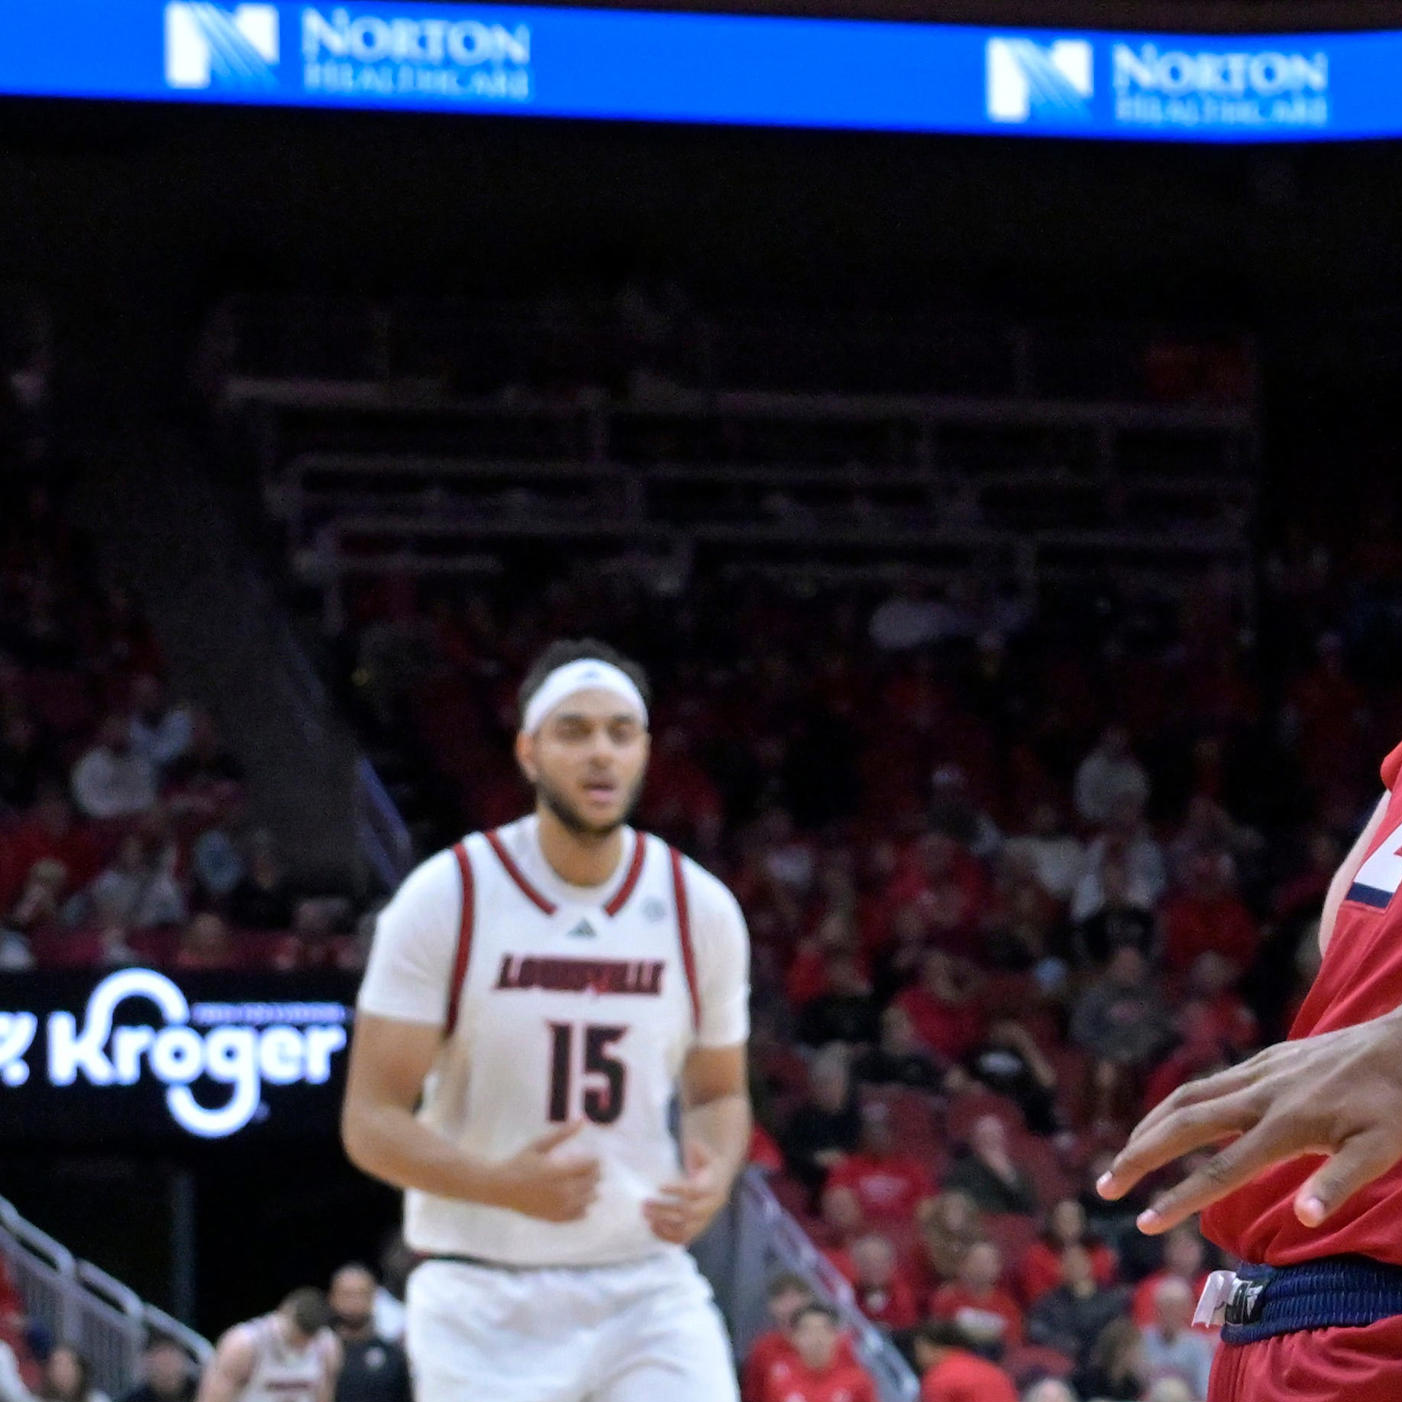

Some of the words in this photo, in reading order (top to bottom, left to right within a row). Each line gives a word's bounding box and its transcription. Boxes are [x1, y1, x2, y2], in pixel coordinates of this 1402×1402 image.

[301, 7, 530, 66] NORTON
[1112, 42, 1328, 93] NORTON
[48, 967, 347, 1138] Kroger
[546, 1020, 630, 1127] 15
